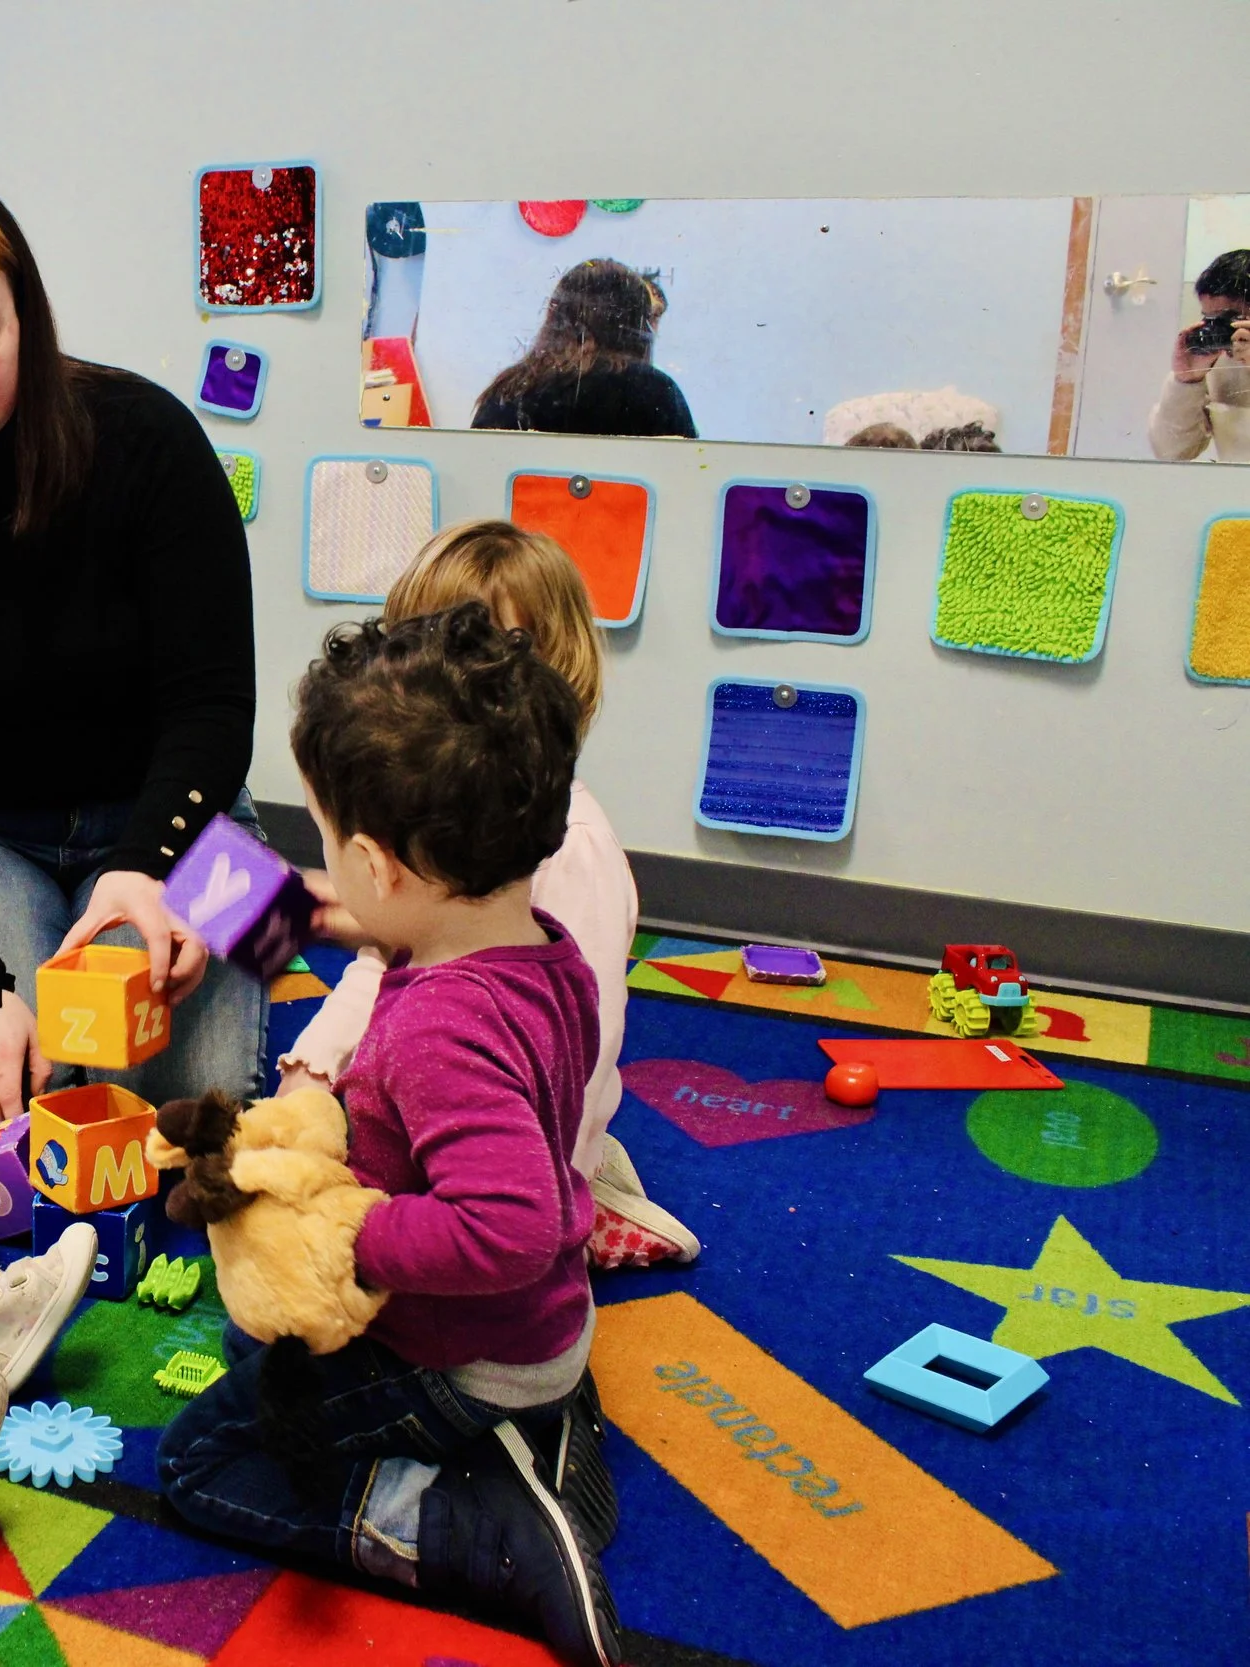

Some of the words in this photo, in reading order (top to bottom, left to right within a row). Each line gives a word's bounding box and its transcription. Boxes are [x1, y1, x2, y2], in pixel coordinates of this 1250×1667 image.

[60, 1006, 98, 1054] Z
[90, 1139, 147, 1205] M
[1018, 1284, 1138, 1319] star
[653, 1360, 866, 1520] rectangle
